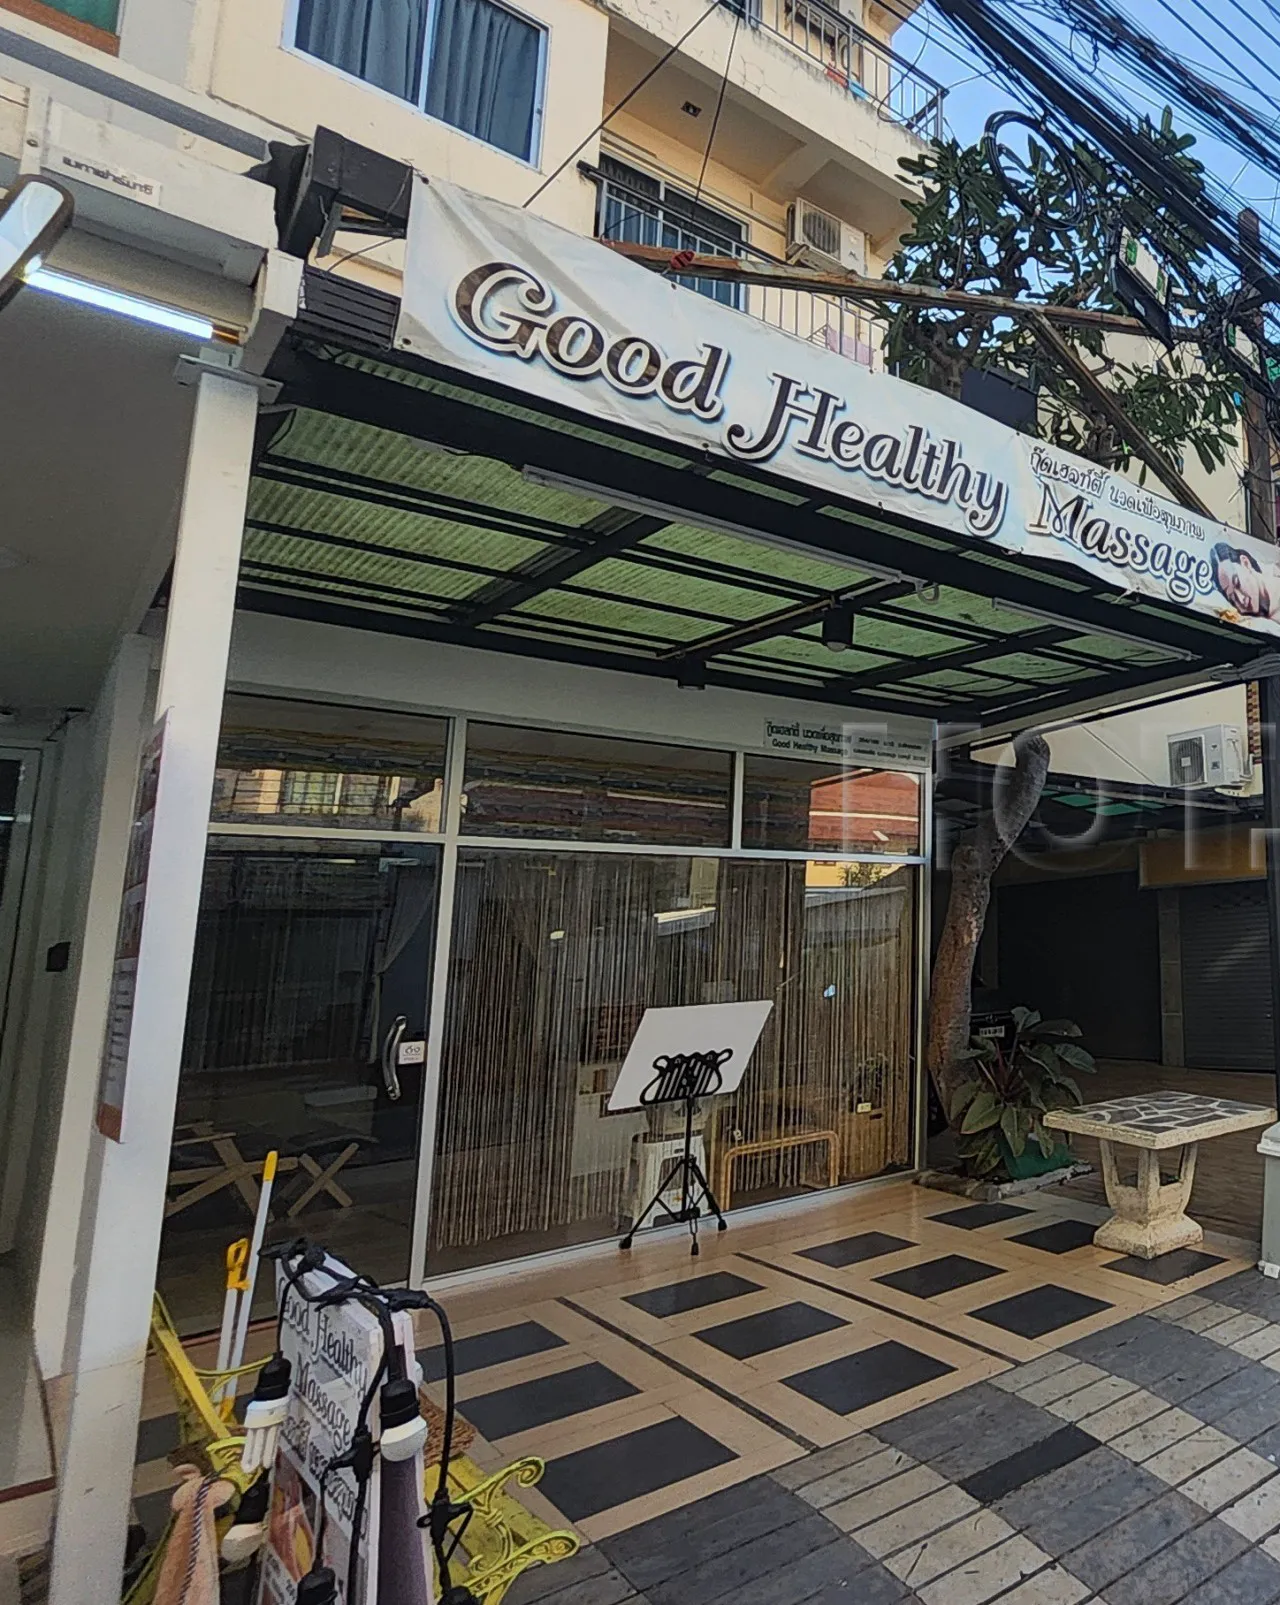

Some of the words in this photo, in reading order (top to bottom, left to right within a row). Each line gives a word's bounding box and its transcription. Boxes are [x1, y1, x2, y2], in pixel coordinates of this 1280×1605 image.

[452, 260, 726, 414] Good
[728, 373, 1007, 536] Healthy
[1027, 482, 1212, 600] Massage
[772, 738, 790, 748] Good
[295, 1352, 351, 1452] Massage
[311, 1310, 368, 1400] Healthy
